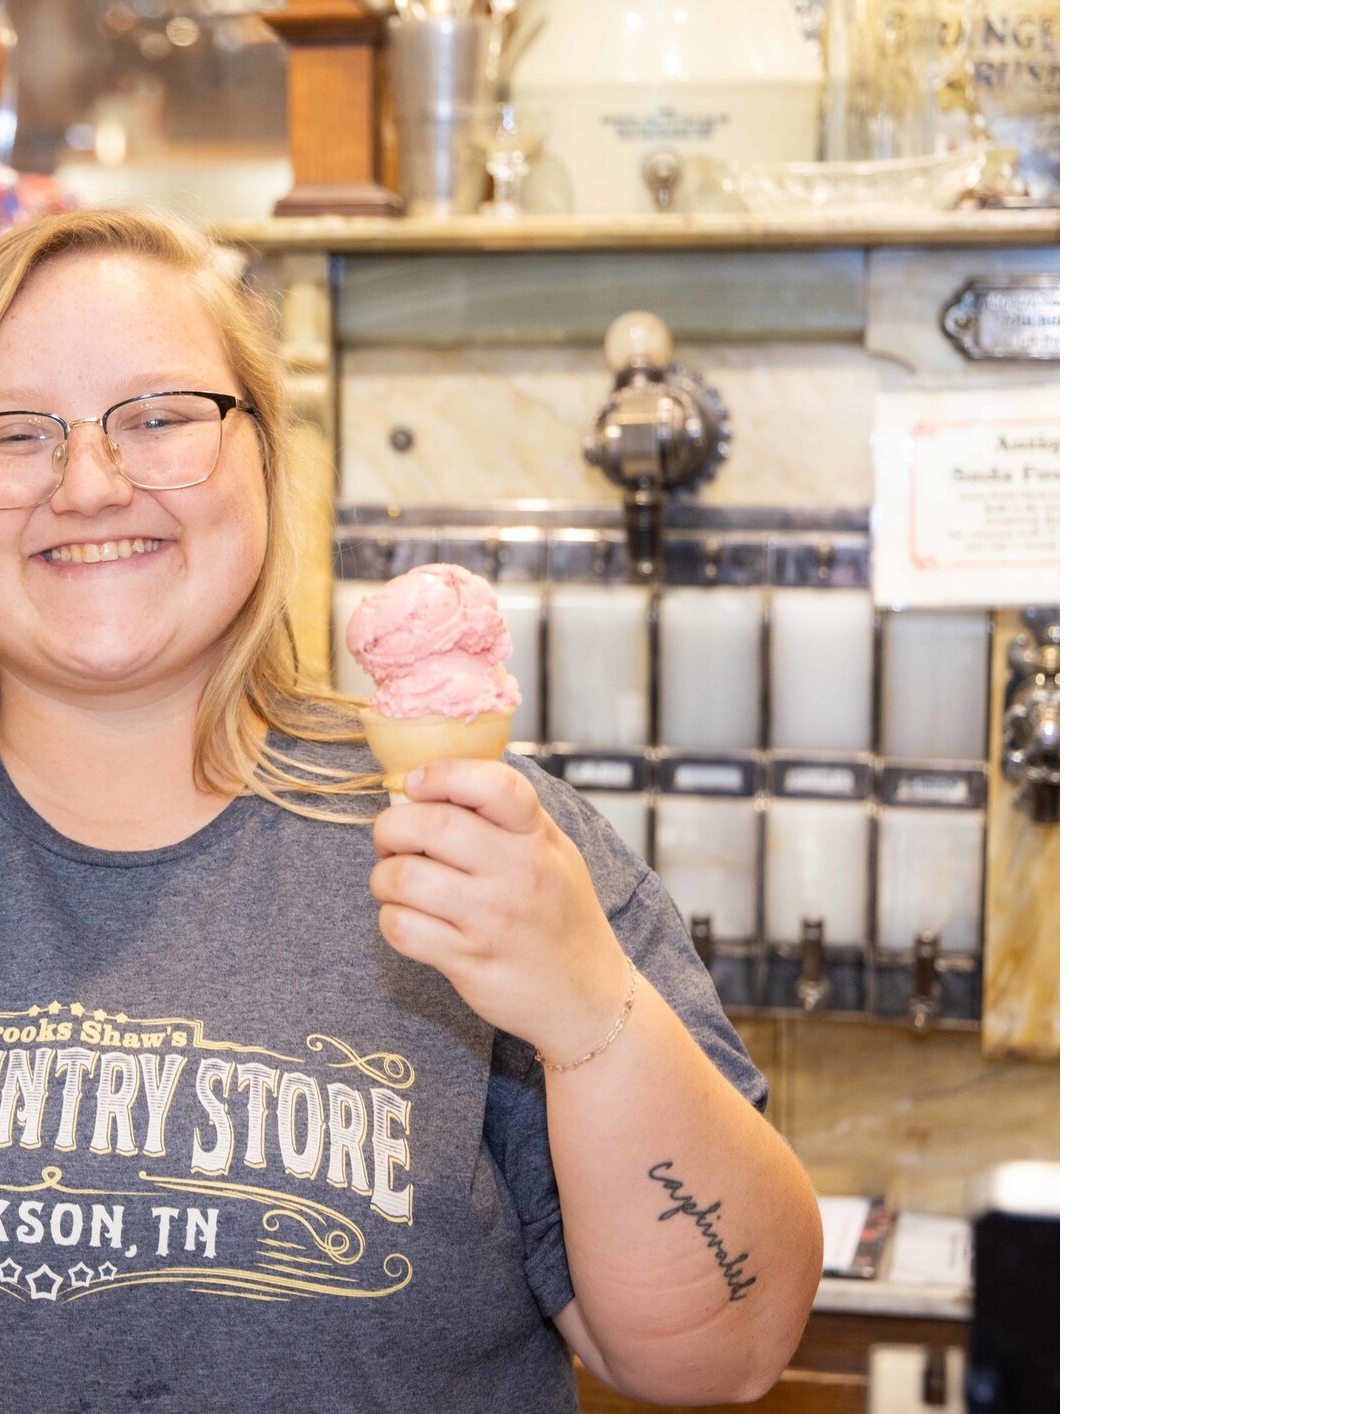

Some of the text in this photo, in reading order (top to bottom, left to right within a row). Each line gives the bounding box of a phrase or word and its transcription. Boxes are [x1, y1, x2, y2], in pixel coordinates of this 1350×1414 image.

[80, 1021, 187, 1048] Shaw's
[190, 1057, 414, 1226] STORE
[152, 1206, 219, 1259] TN
